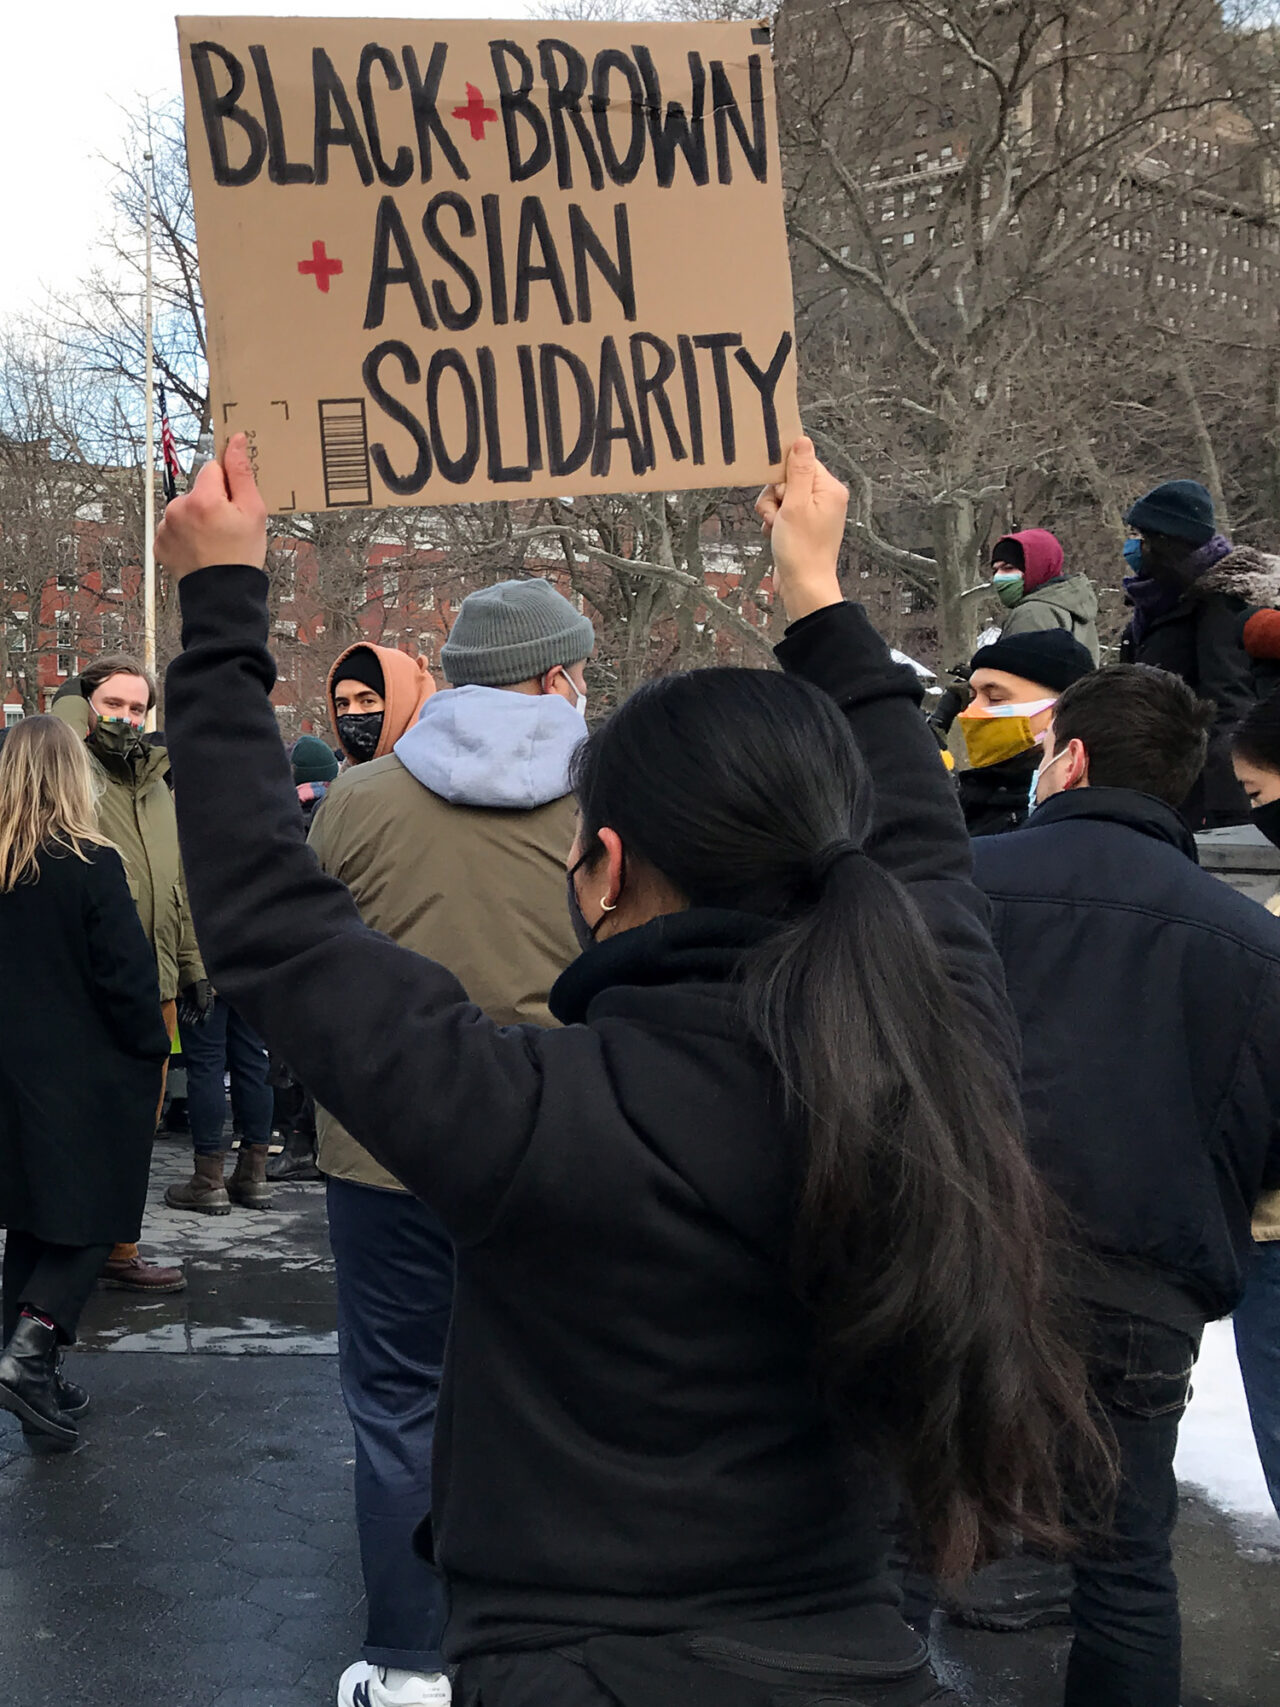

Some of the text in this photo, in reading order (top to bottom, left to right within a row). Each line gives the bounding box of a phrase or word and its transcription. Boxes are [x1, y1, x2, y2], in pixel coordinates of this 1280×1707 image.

[190, 41, 470, 187] BLACK
[489, 39, 767, 190] BROWN
[363, 191, 637, 330] ASIAN
[363, 330, 792, 495] SOLIDARITY
